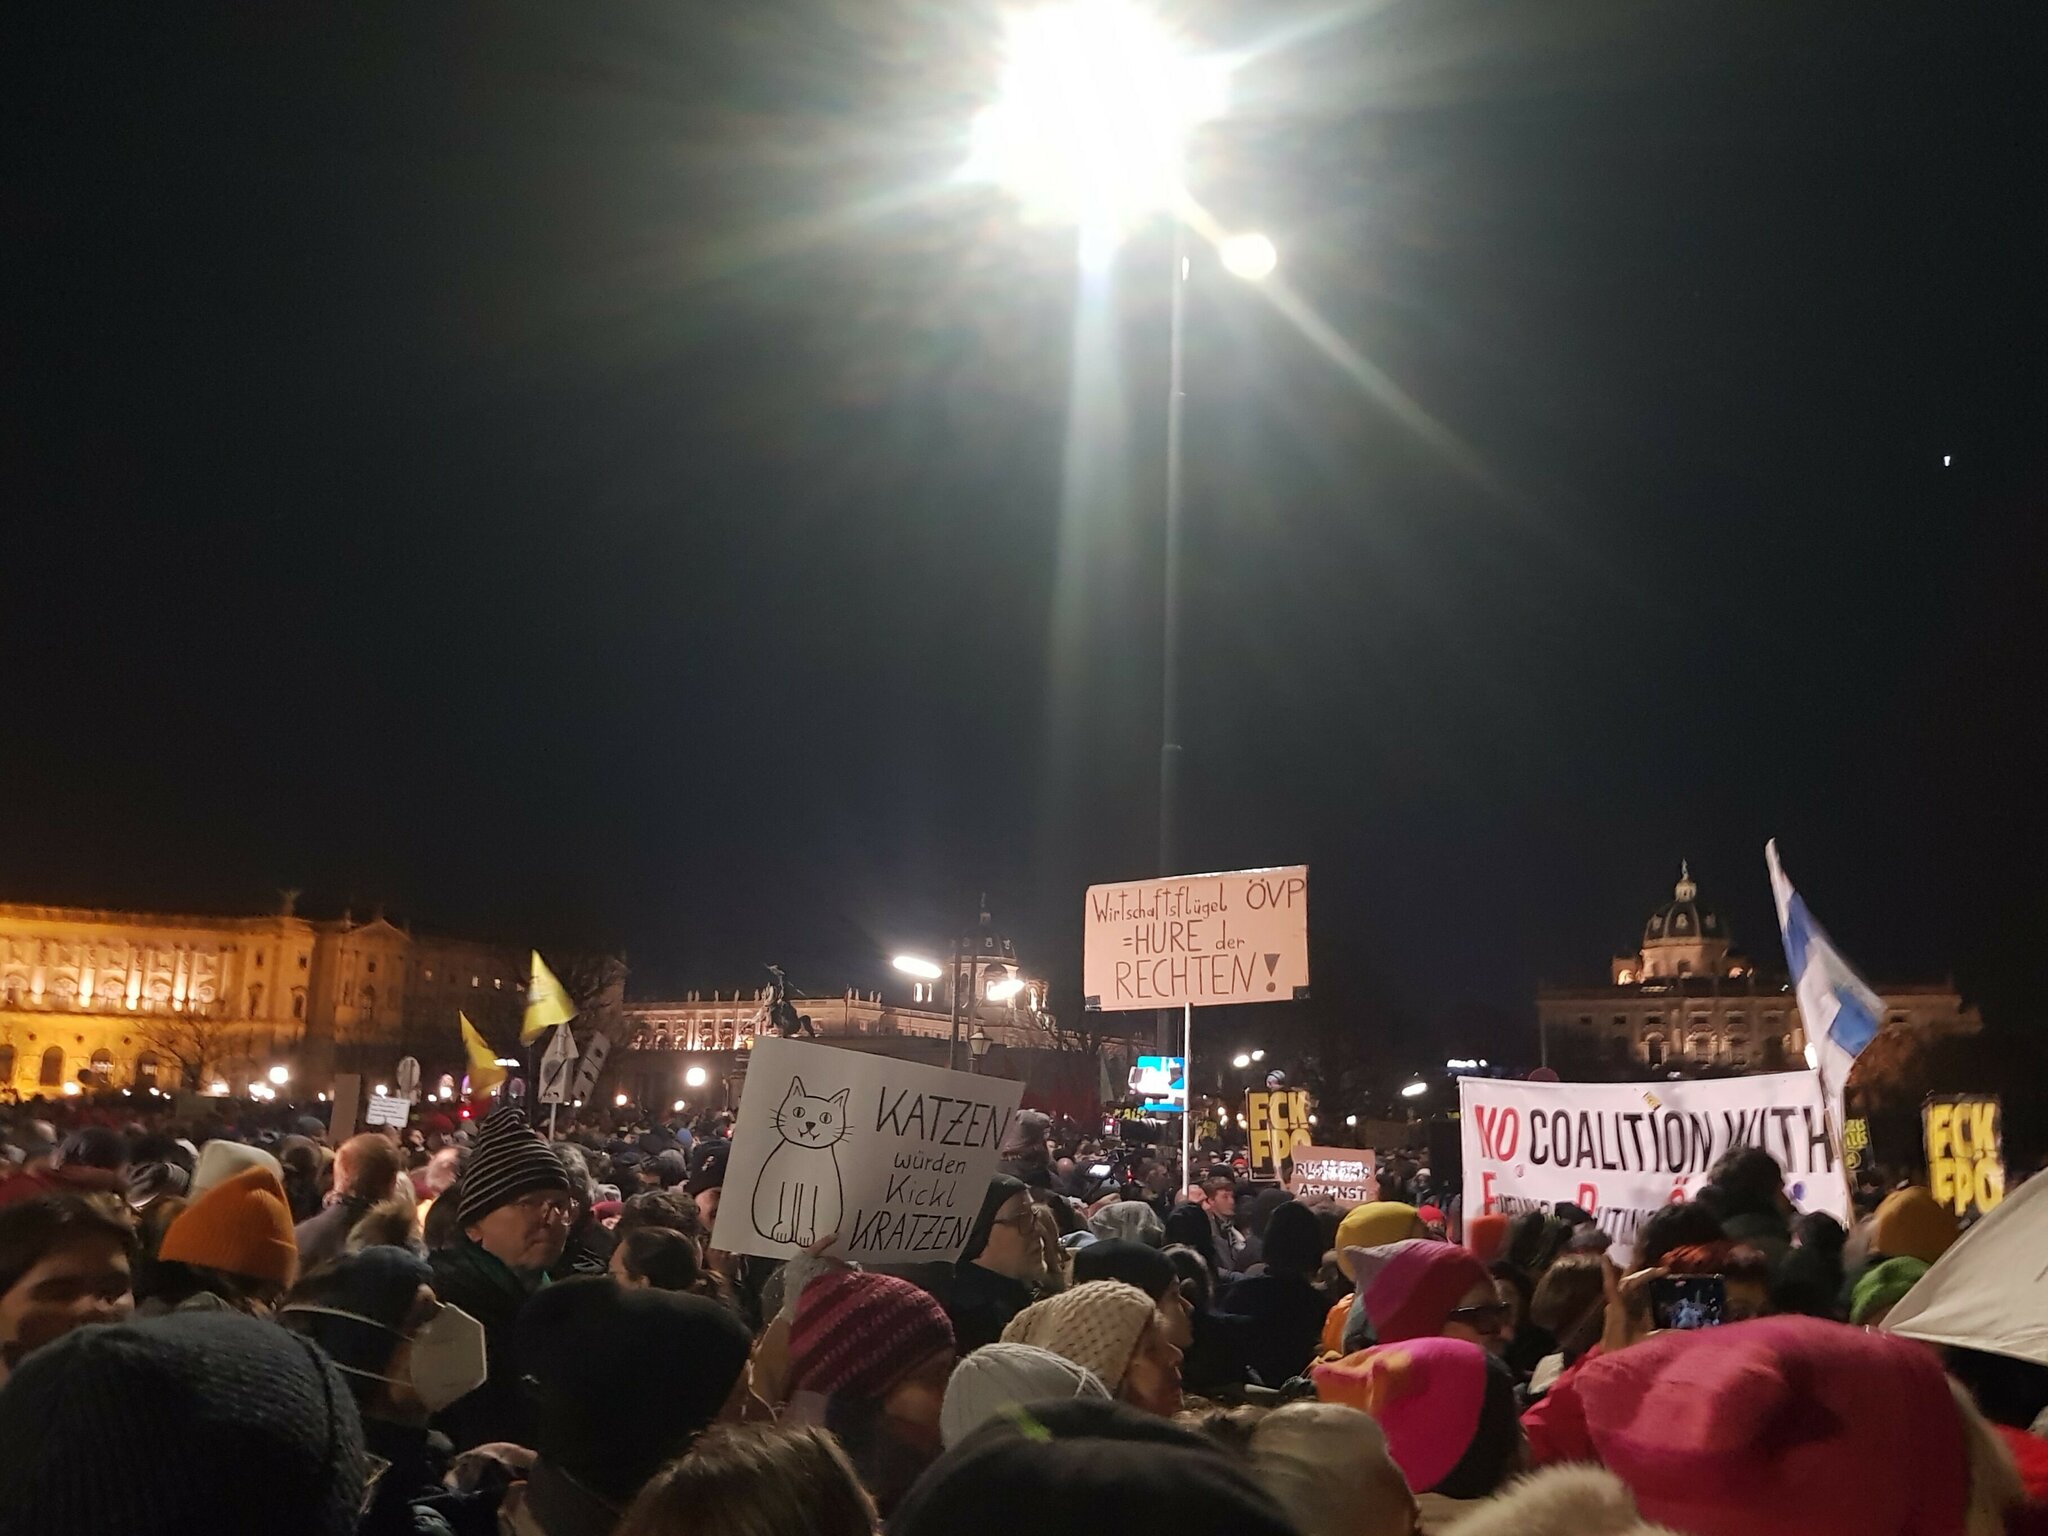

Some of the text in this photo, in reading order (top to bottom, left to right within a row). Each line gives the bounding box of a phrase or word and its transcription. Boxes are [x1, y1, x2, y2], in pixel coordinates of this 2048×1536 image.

[1092, 877, 1305, 923] Wirtschaftsflügel ÖVP
[1215, 919, 1246, 950] der
[1115, 951, 1281, 1000] RECHTEN!
[876, 1086, 1011, 1150] KATZEN
[1249, 1091, 1309, 1130] FCK
[1928, 1103, 1998, 1158] FCK
[1529, 1108, 1713, 1174] COALITION
[1723, 1105, 1836, 1174] WITH
[894, 1150, 966, 1175] würden
[885, 1174, 956, 1208] Kickl
[1300, 1184, 1367, 1201] AGAINST
[848, 1209, 972, 1251] KRATZEN
